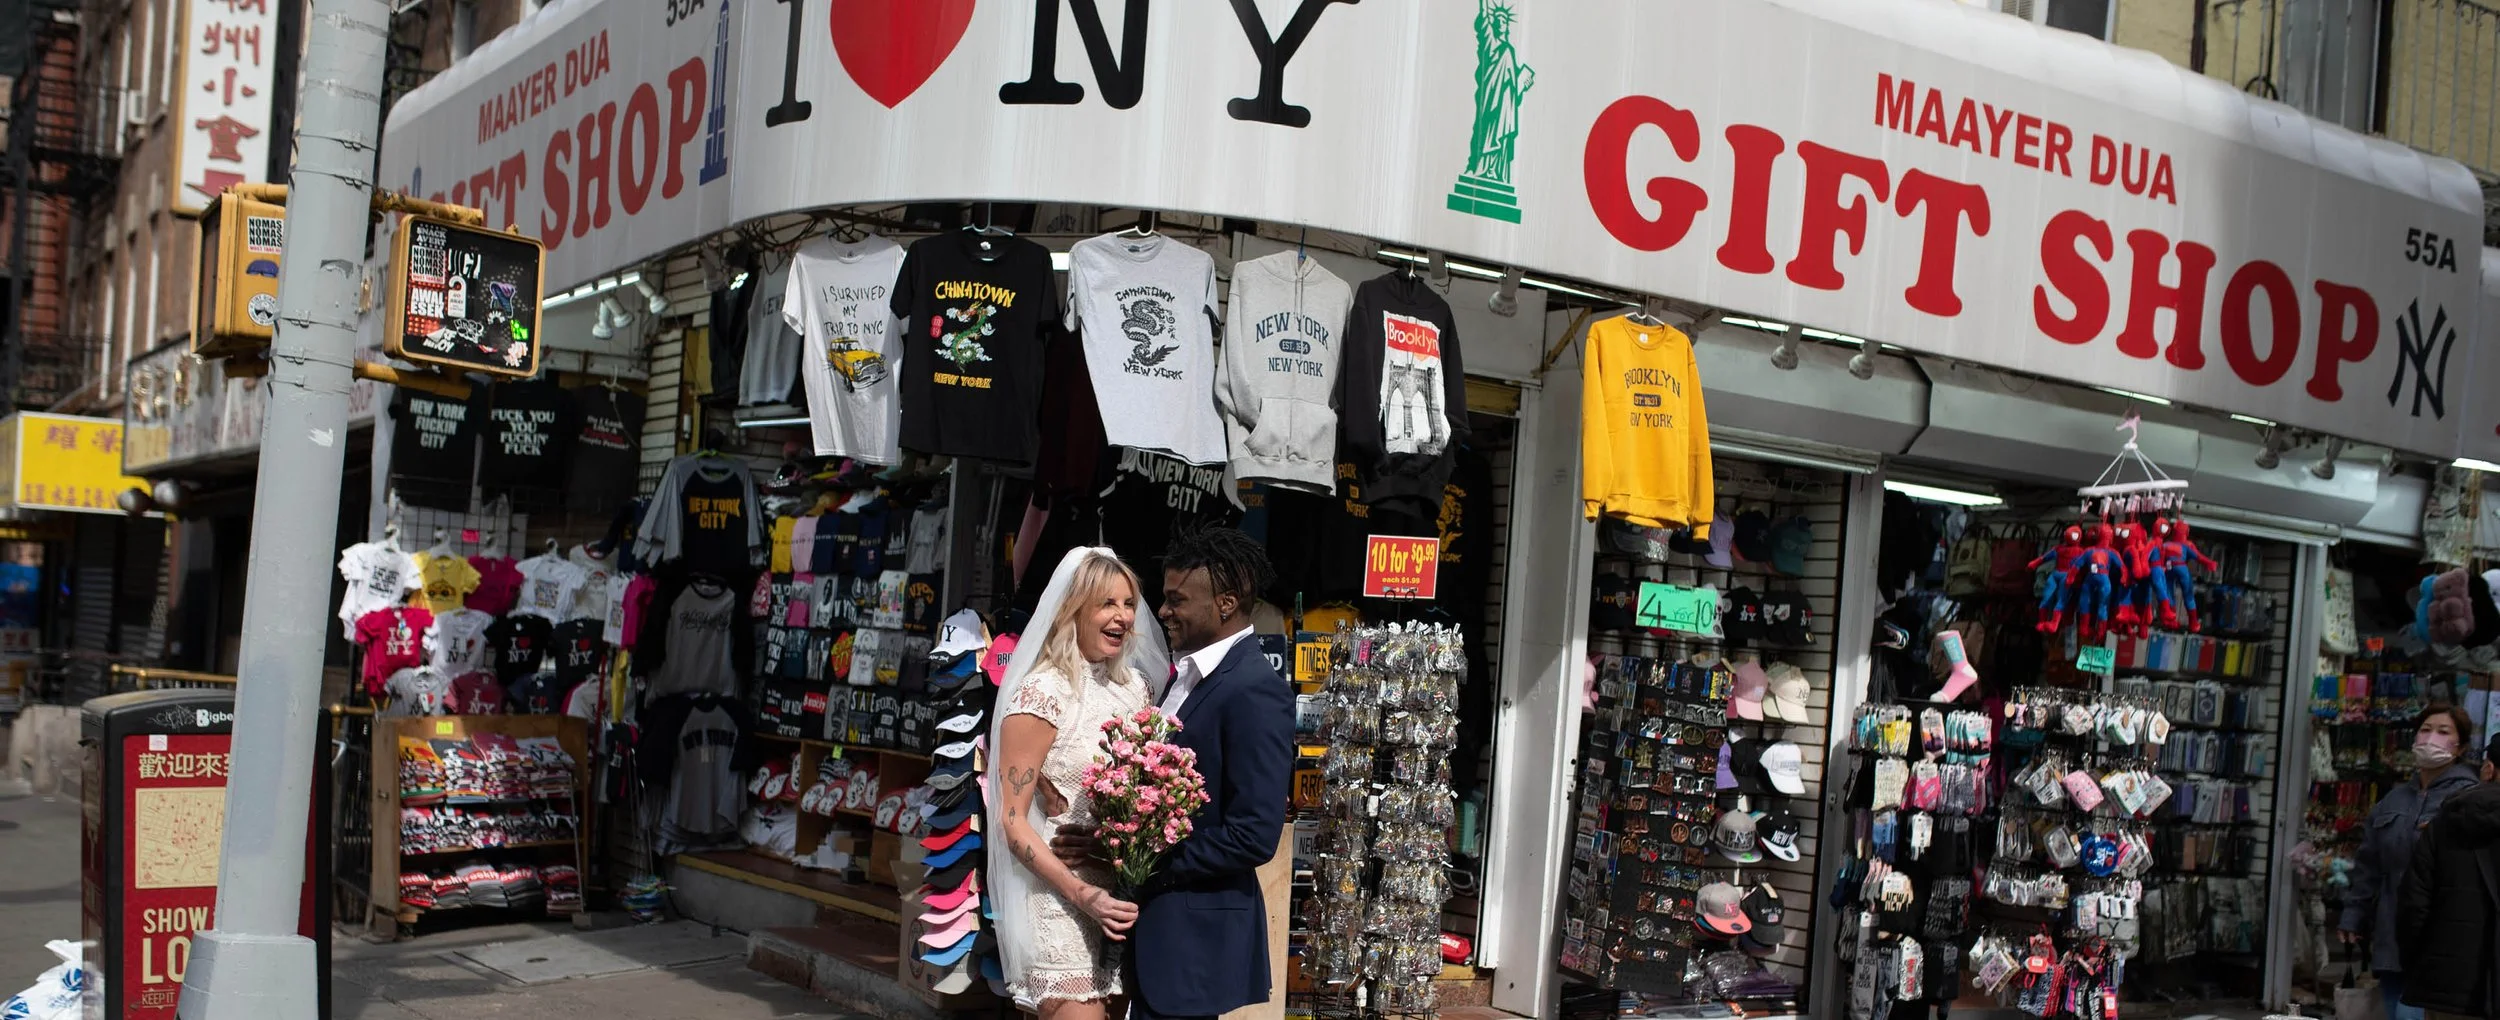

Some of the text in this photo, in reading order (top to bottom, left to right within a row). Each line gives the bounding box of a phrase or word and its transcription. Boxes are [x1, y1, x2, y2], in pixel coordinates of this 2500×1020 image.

[998, 0, 1361, 129] NY
[478, 28, 610, 146] MAAYER DUA
[1874, 72, 2178, 206] MAAYER DUA
[541, 55, 707, 252] SHOP
[413, 247, 445, 260] NOMAS
[1583, 94, 2379, 402] GIFT SHOP
[2404, 226, 2458, 274] 55A
[413, 256, 445, 268] NOMAS
[413, 264, 444, 277] NOMAS
[823, 285, 886, 303] I SURVIVED
[935, 281, 1017, 308] CHINATOWN
[1115, 286, 1176, 303] CHINATOWN
[843, 304, 858, 317] MY
[825, 320, 884, 336] TRIP TO NYC
[1256, 311, 1330, 352] NEW YORK
[1388, 321, 1438, 353] Brooklyn
[1123, 360, 1184, 381] NEW YORK
[1268, 357, 1324, 378] NEW YORK
[934, 371, 993, 389] NEW YORK
[410, 398, 467, 421] NEW YORK
[491, 408, 556, 424] FUCK YOU
[415, 416, 458, 436] FUCKIN
[510, 421, 538, 435] YOU
[1643, 412, 1674, 429] YORK
[420, 432, 447, 450] CITY
[505, 441, 542, 457] FUCK
[1155, 457, 1186, 483] NEW
[1189, 465, 1224, 498] YORK
[689, 496, 742, 518] NEW YORK
[1167, 484, 1203, 514] CITY
[700, 511, 727, 531] CITY
[1372, 541, 1436, 575] 10 for $9.99
[1381, 576, 1400, 584] each
[1639, 593, 1667, 628] 4
[386, 640, 415, 656] NY
[447, 650, 472, 664] NY
[508, 648, 533, 664] NY
[568, 650, 593, 668] NY
[142, 906, 209, 934] SHOW
[141, 991, 175, 1006] KEEP IT
